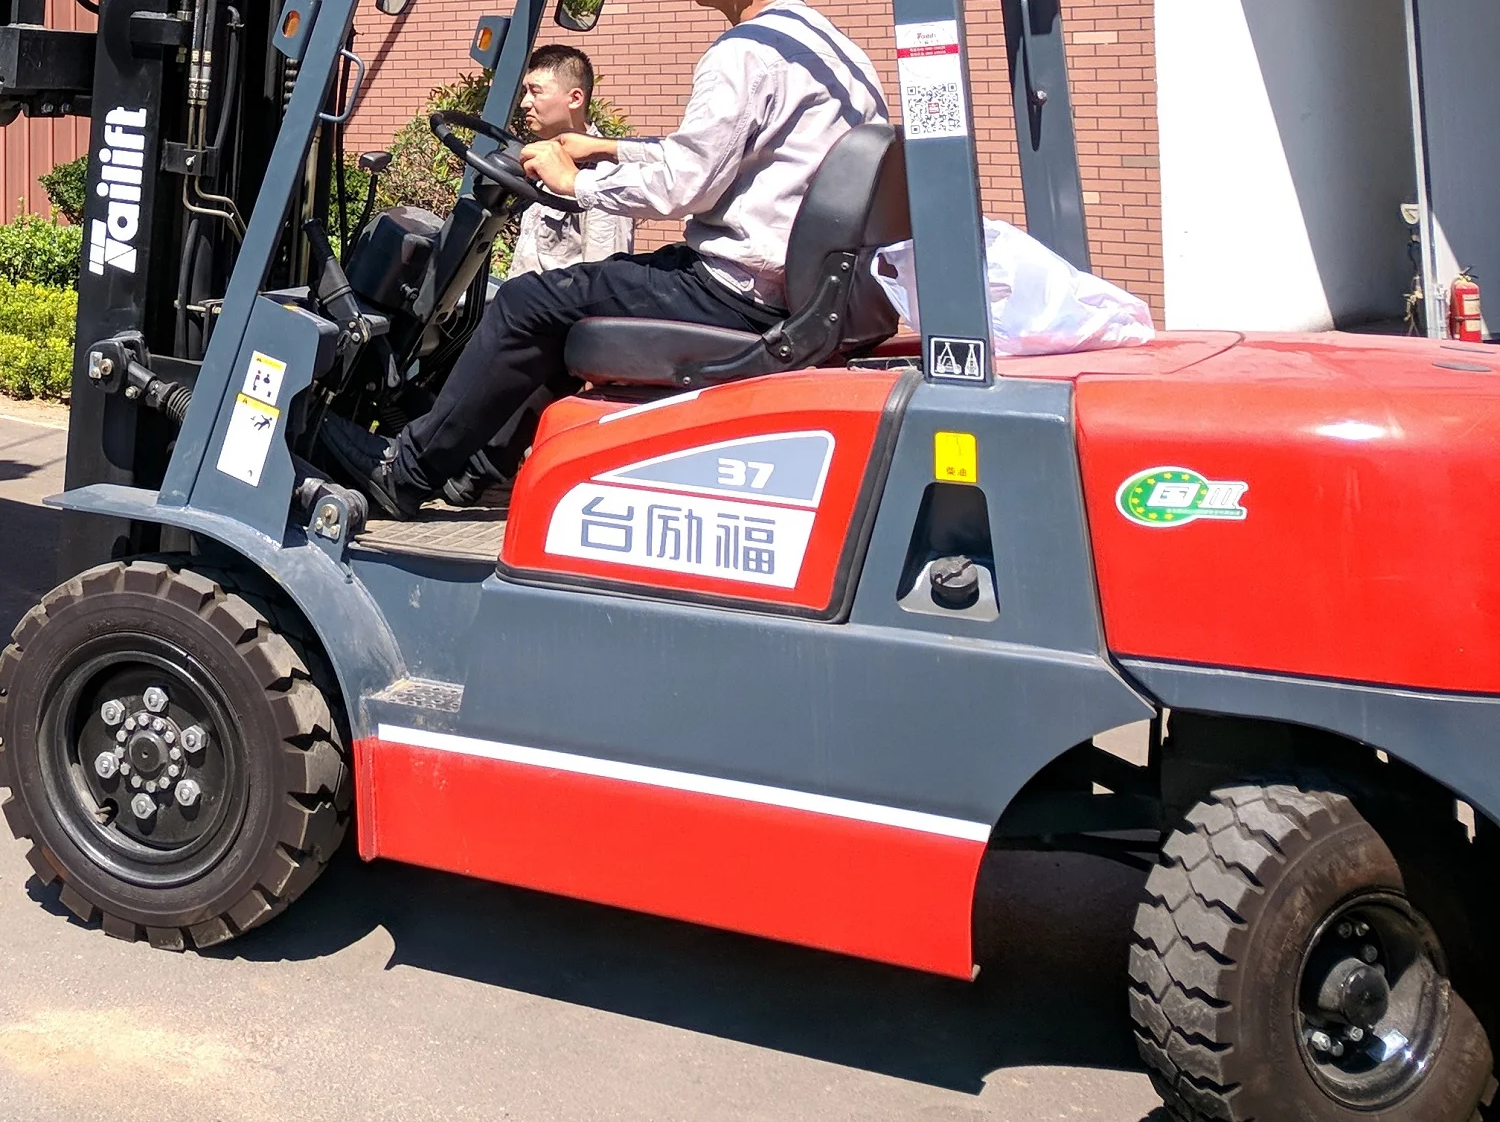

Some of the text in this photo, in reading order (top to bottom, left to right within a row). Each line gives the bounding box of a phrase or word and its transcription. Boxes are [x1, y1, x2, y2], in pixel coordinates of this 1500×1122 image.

[88, 106, 147, 276] Tailift
[716, 457, 775, 489] 37
[580, 496, 776, 575] 台励福
